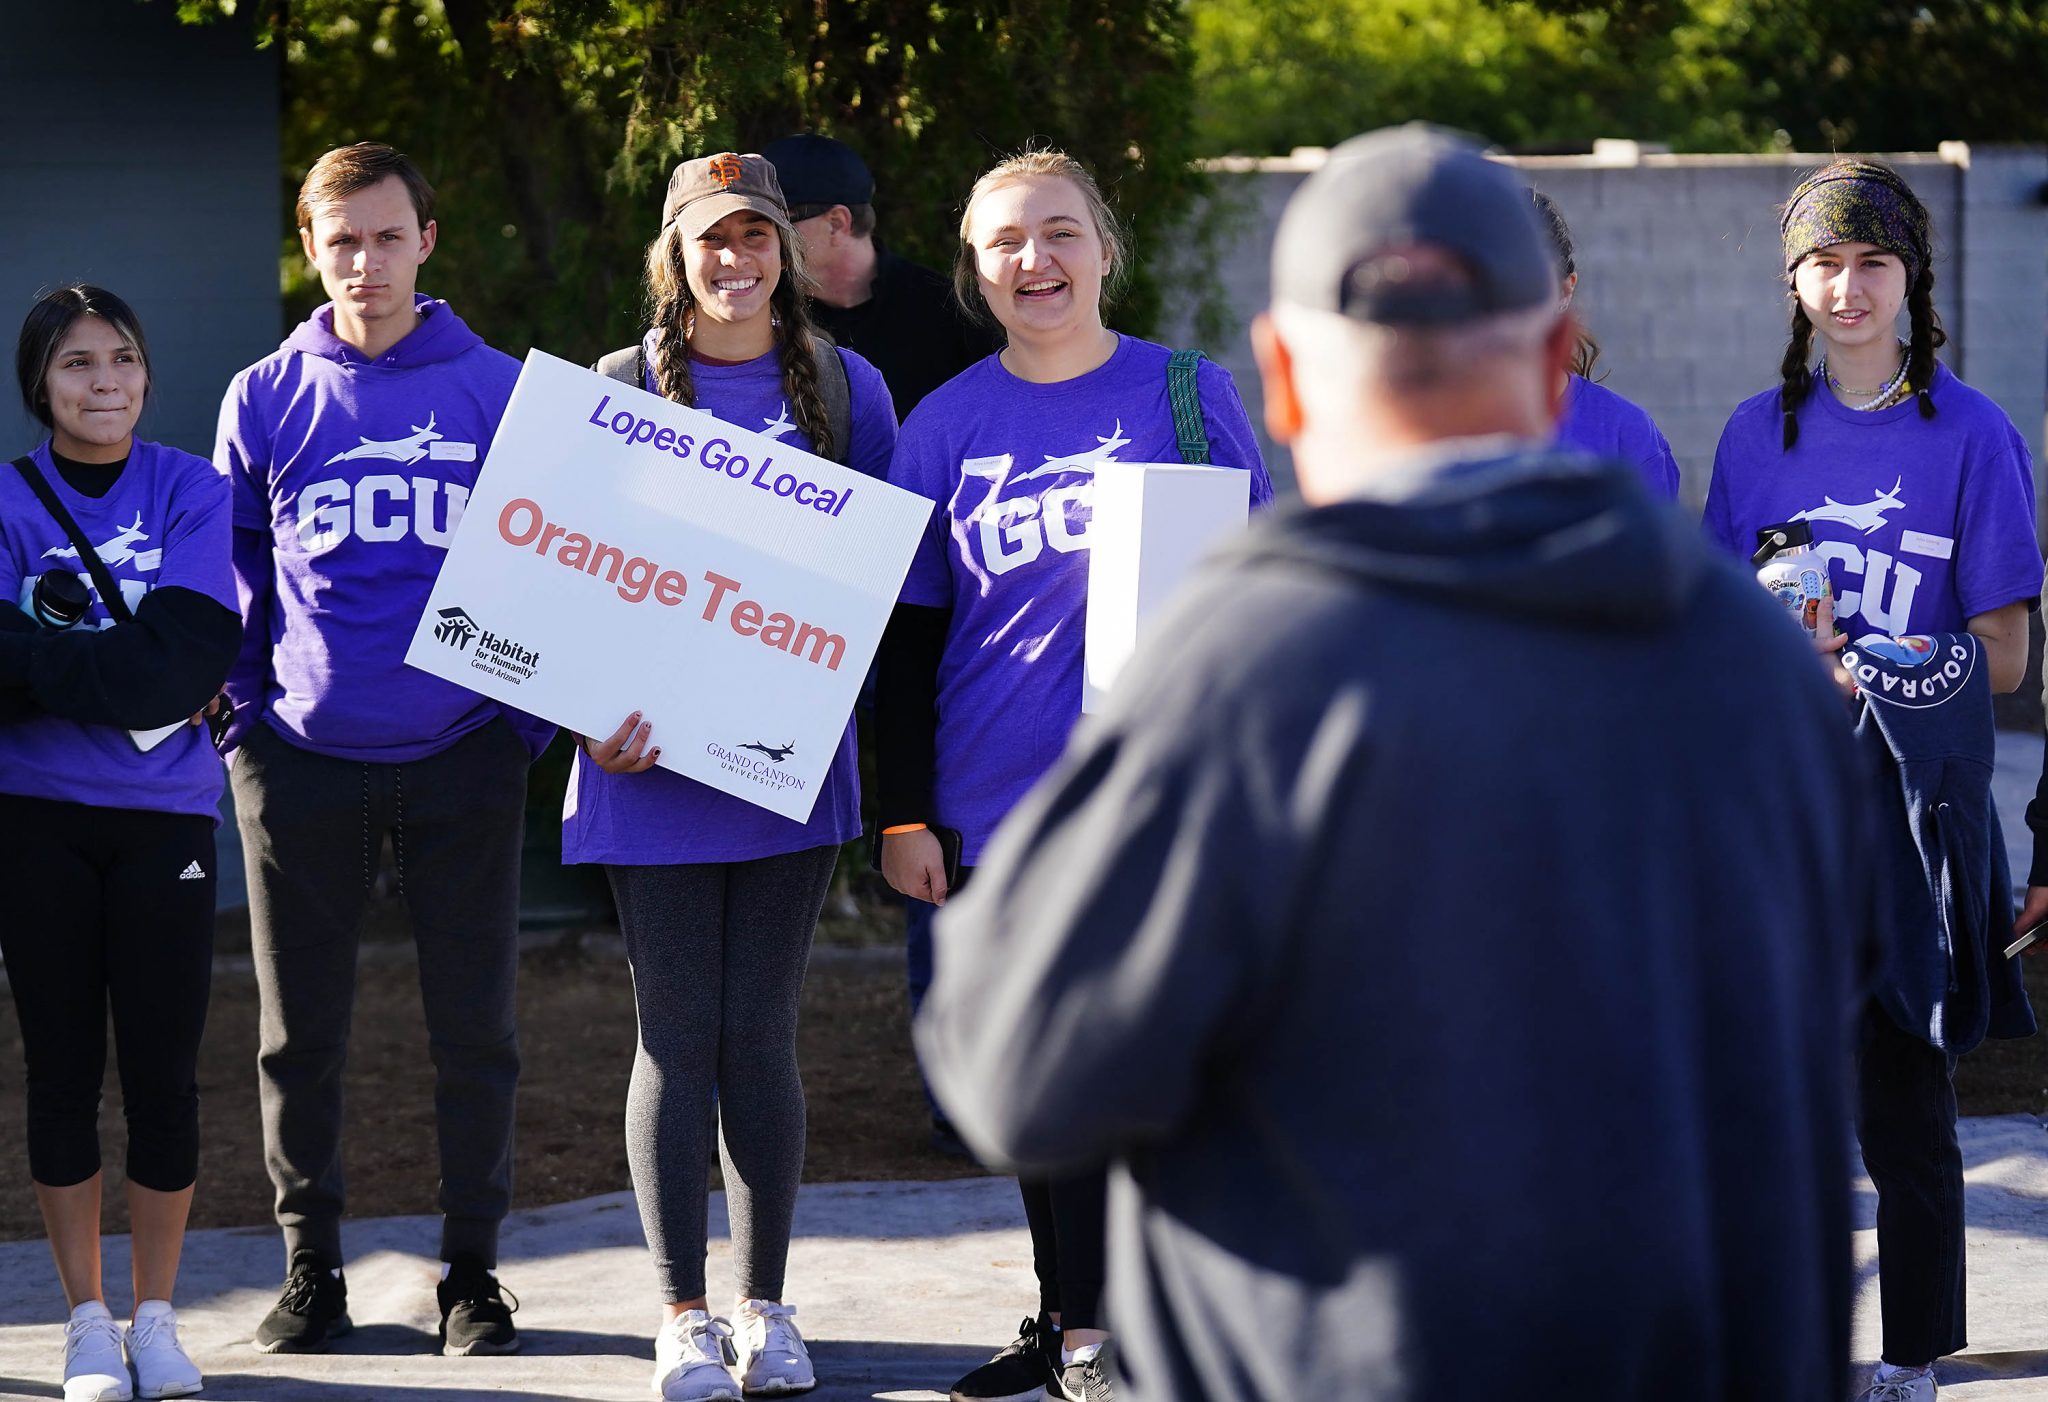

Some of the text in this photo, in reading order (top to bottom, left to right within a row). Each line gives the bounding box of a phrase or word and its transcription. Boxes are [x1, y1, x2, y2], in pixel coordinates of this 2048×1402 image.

[588, 395, 854, 517] Lopes Go Local
[296, 474, 470, 552] GCU
[498, 498, 847, 671] Orange Team
[475, 648, 489, 660] for
[479, 630, 540, 668] Habitat
[471, 659, 521, 685] Central Arizona
[1841, 645, 1967, 698] COLORADO
[706, 742, 806, 790] GRAND CANYON
[721, 762, 783, 791] UNIVERSITY
[179, 871, 206, 879] adidas
